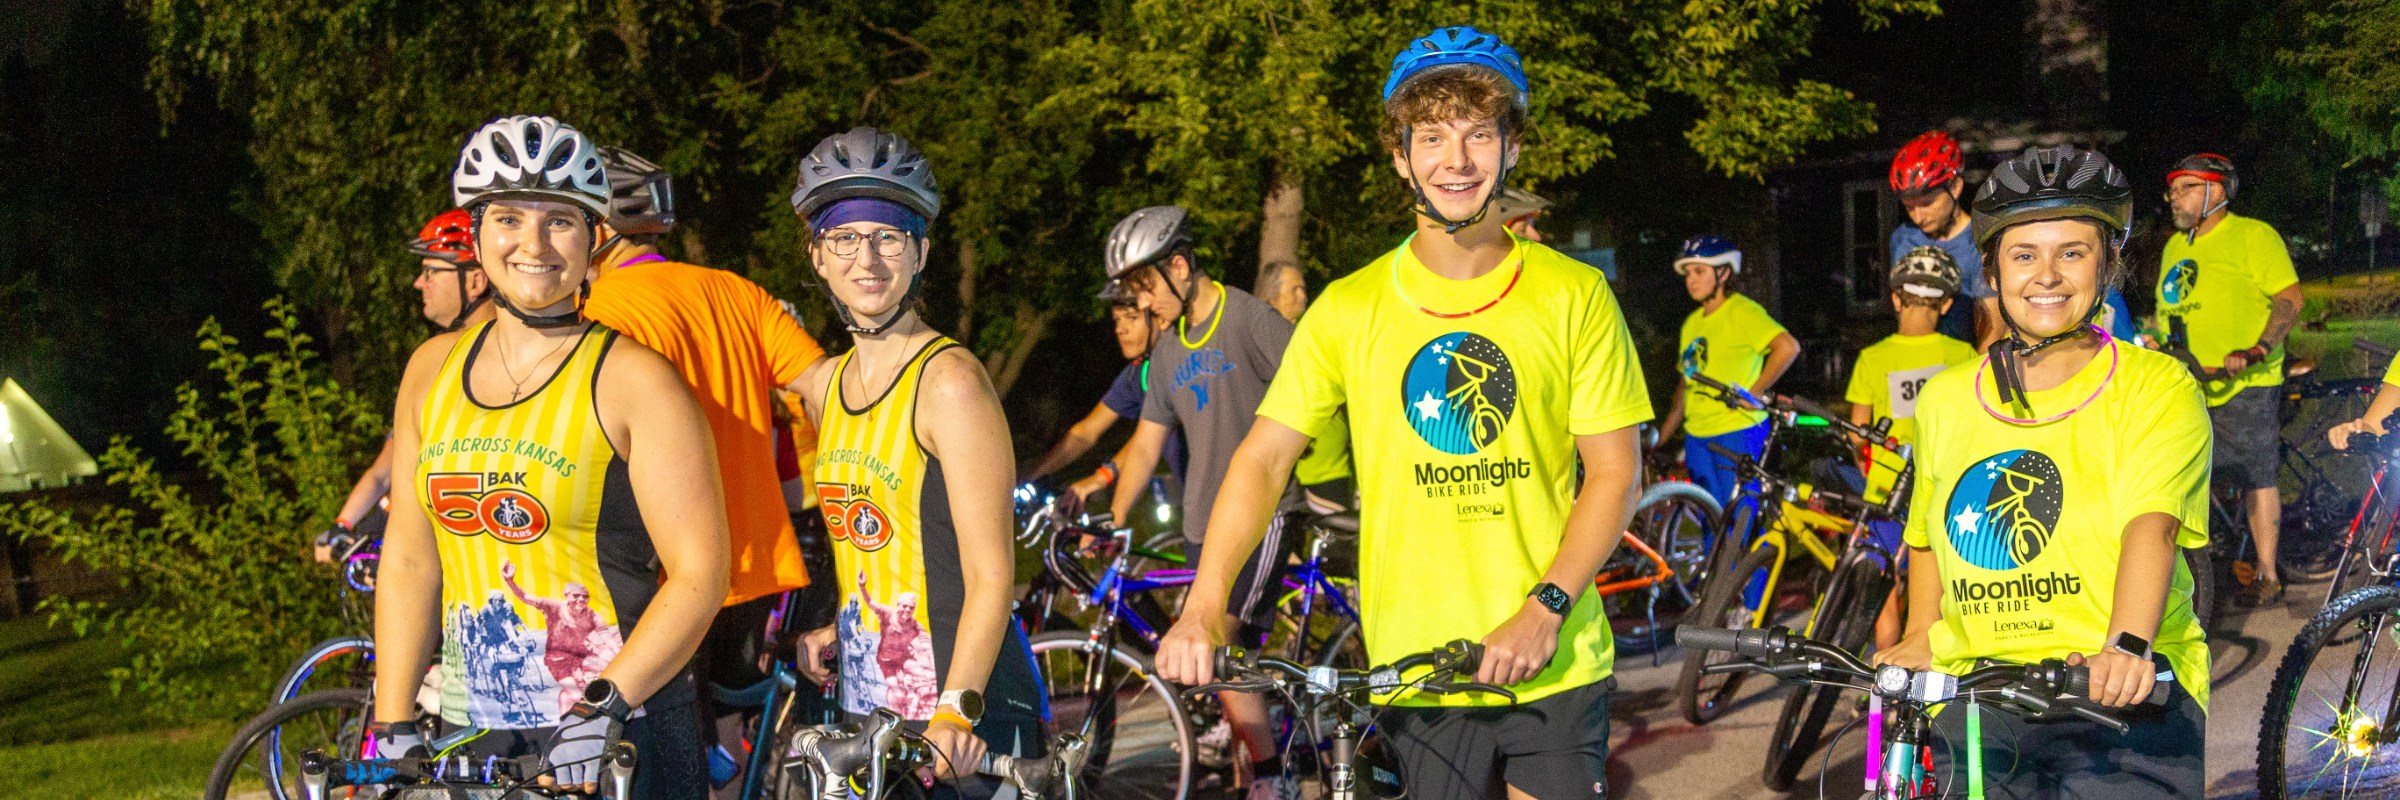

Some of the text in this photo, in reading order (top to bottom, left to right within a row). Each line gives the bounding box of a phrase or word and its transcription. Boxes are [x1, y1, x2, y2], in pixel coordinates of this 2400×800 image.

[450, 437, 512, 454] ACROSS
[514, 439, 577, 478] KANSAS
[828, 449, 863, 465] ACROSS
[863, 453, 903, 492] KANSAS
[1414, 456, 1531, 488] Moonlight
[488, 471, 528, 488] BAK
[850, 483, 873, 500] BAK
[1426, 482, 1487, 499] BIKE RIDE
[426, 471, 551, 546] 50
[816, 481, 894, 553] 50
[1457, 503, 1493, 515] Lenexa
[499, 528, 533, 539] YEARS
[854, 535, 880, 546] YEARS
[1952, 571, 2081, 603] Moonlight
[1962, 599, 2030, 616] BIKE RIDE
[1994, 619, 2038, 632] Lenexa
